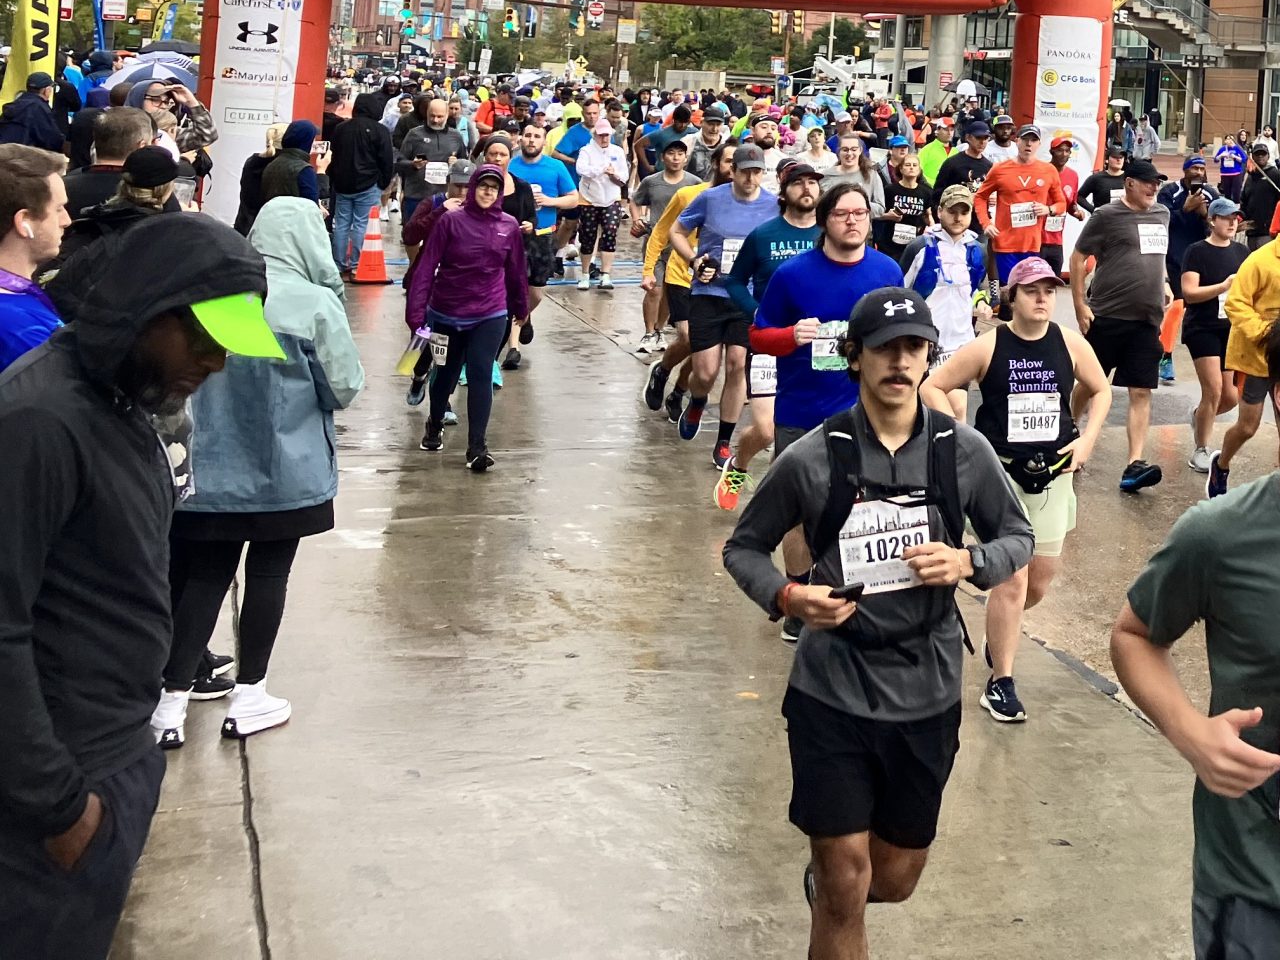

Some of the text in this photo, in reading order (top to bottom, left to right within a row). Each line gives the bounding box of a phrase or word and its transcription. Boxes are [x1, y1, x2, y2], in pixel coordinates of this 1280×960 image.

[1060, 74, 1096, 84] CFG Bank
[1040, 110, 1093, 119] MedStar Health
[770, 240, 814, 251] BALTIM
[1008, 359, 1043, 370] Below
[760, 370, 777, 381] 304
[1008, 369, 1056, 382] Average
[1009, 381, 1059, 393] Running
[1022, 415, 1057, 430] 50487
[864, 531, 925, 564] 10280
